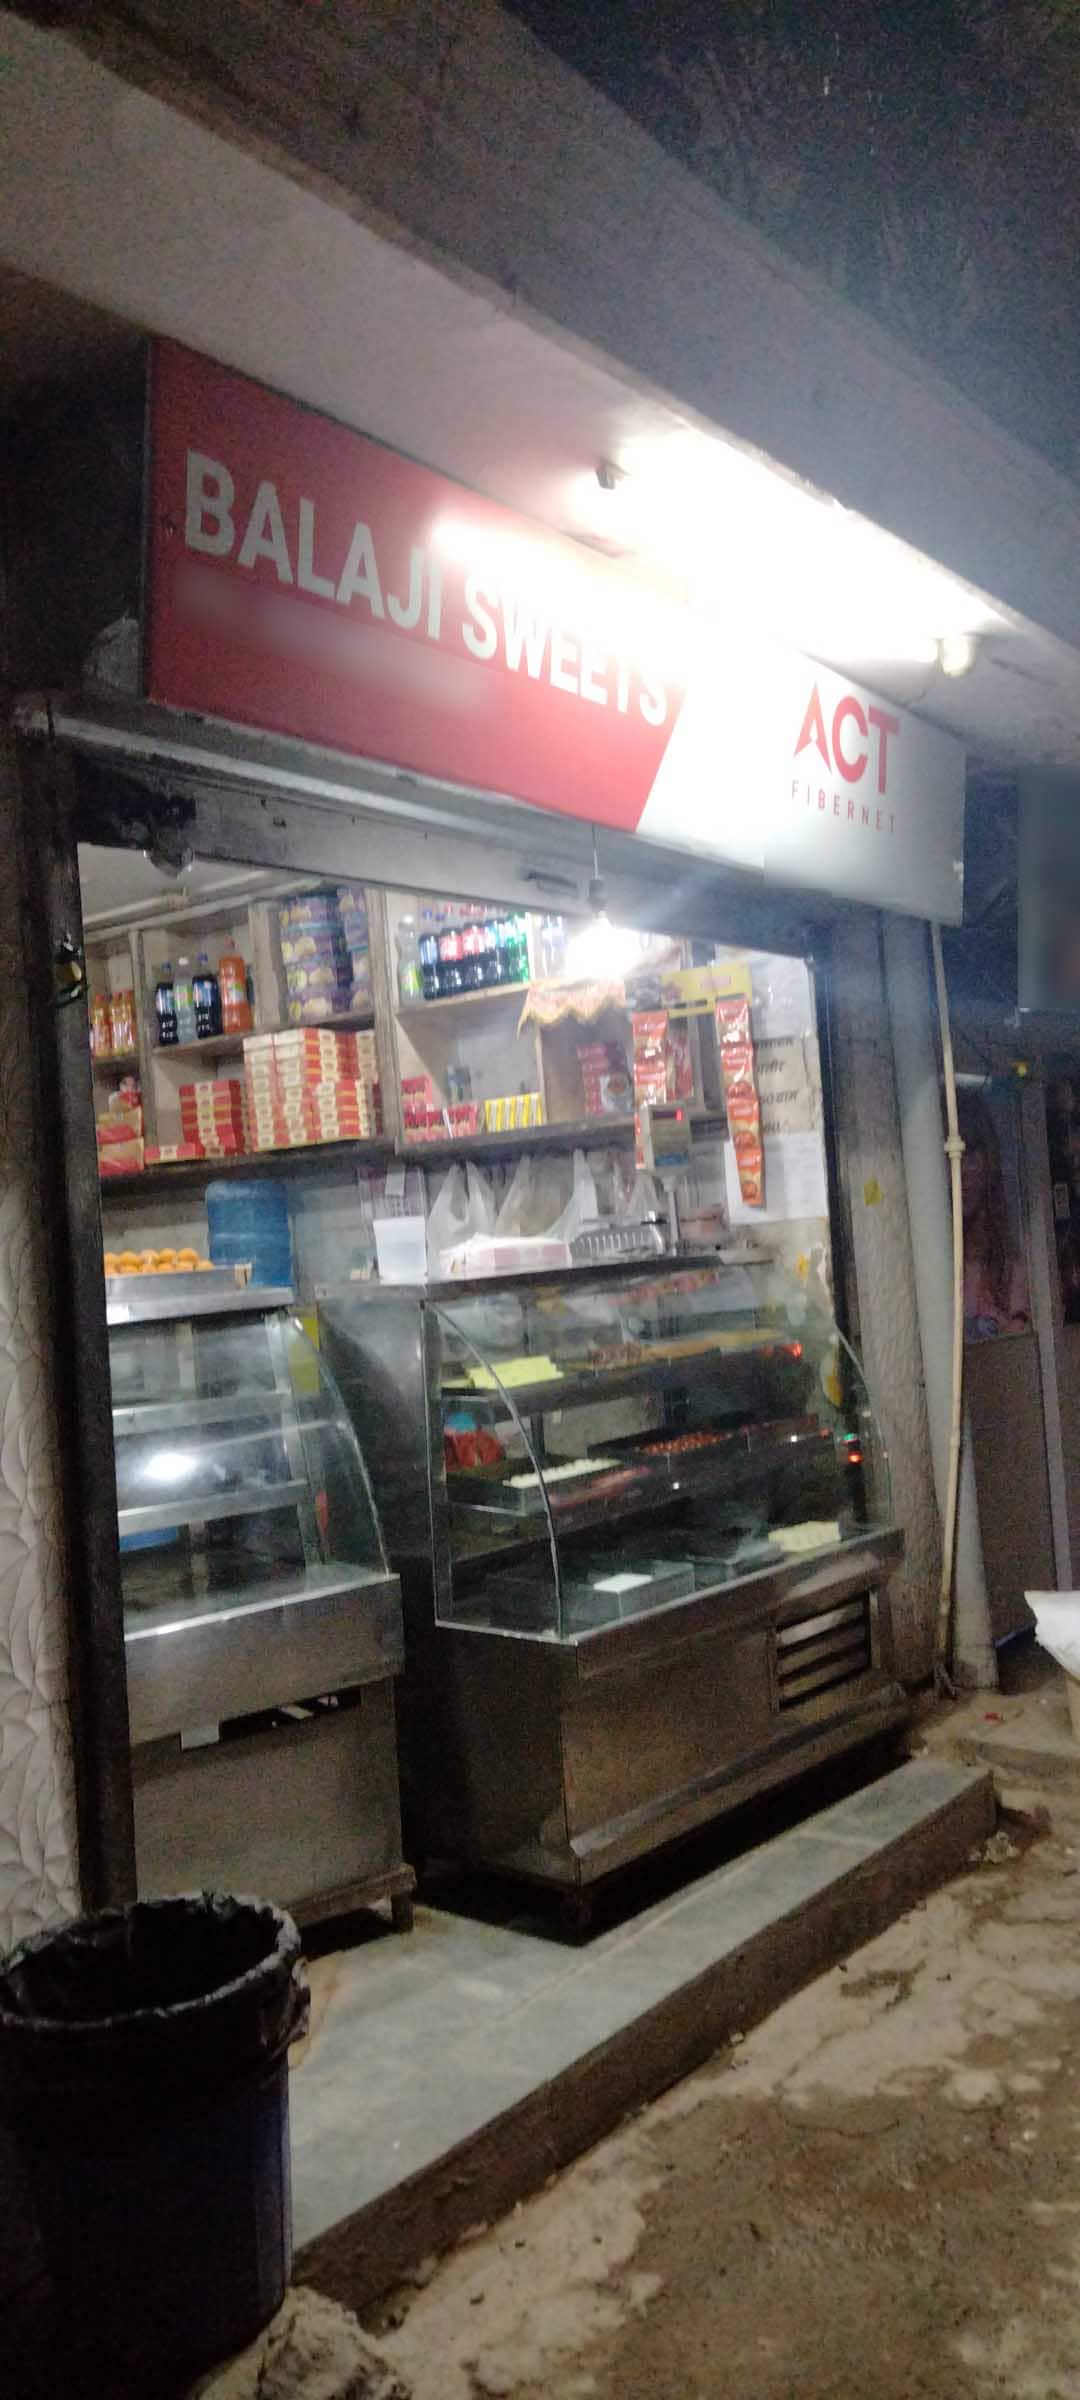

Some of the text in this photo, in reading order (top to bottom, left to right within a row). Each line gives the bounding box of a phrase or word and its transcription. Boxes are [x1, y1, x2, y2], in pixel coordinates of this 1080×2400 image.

[184, 447, 443, 641] BALAJI
[462, 570, 669, 726] SWEETS
[793, 680, 900, 795] ACT
[791, 779, 896, 833] FIBERNET
